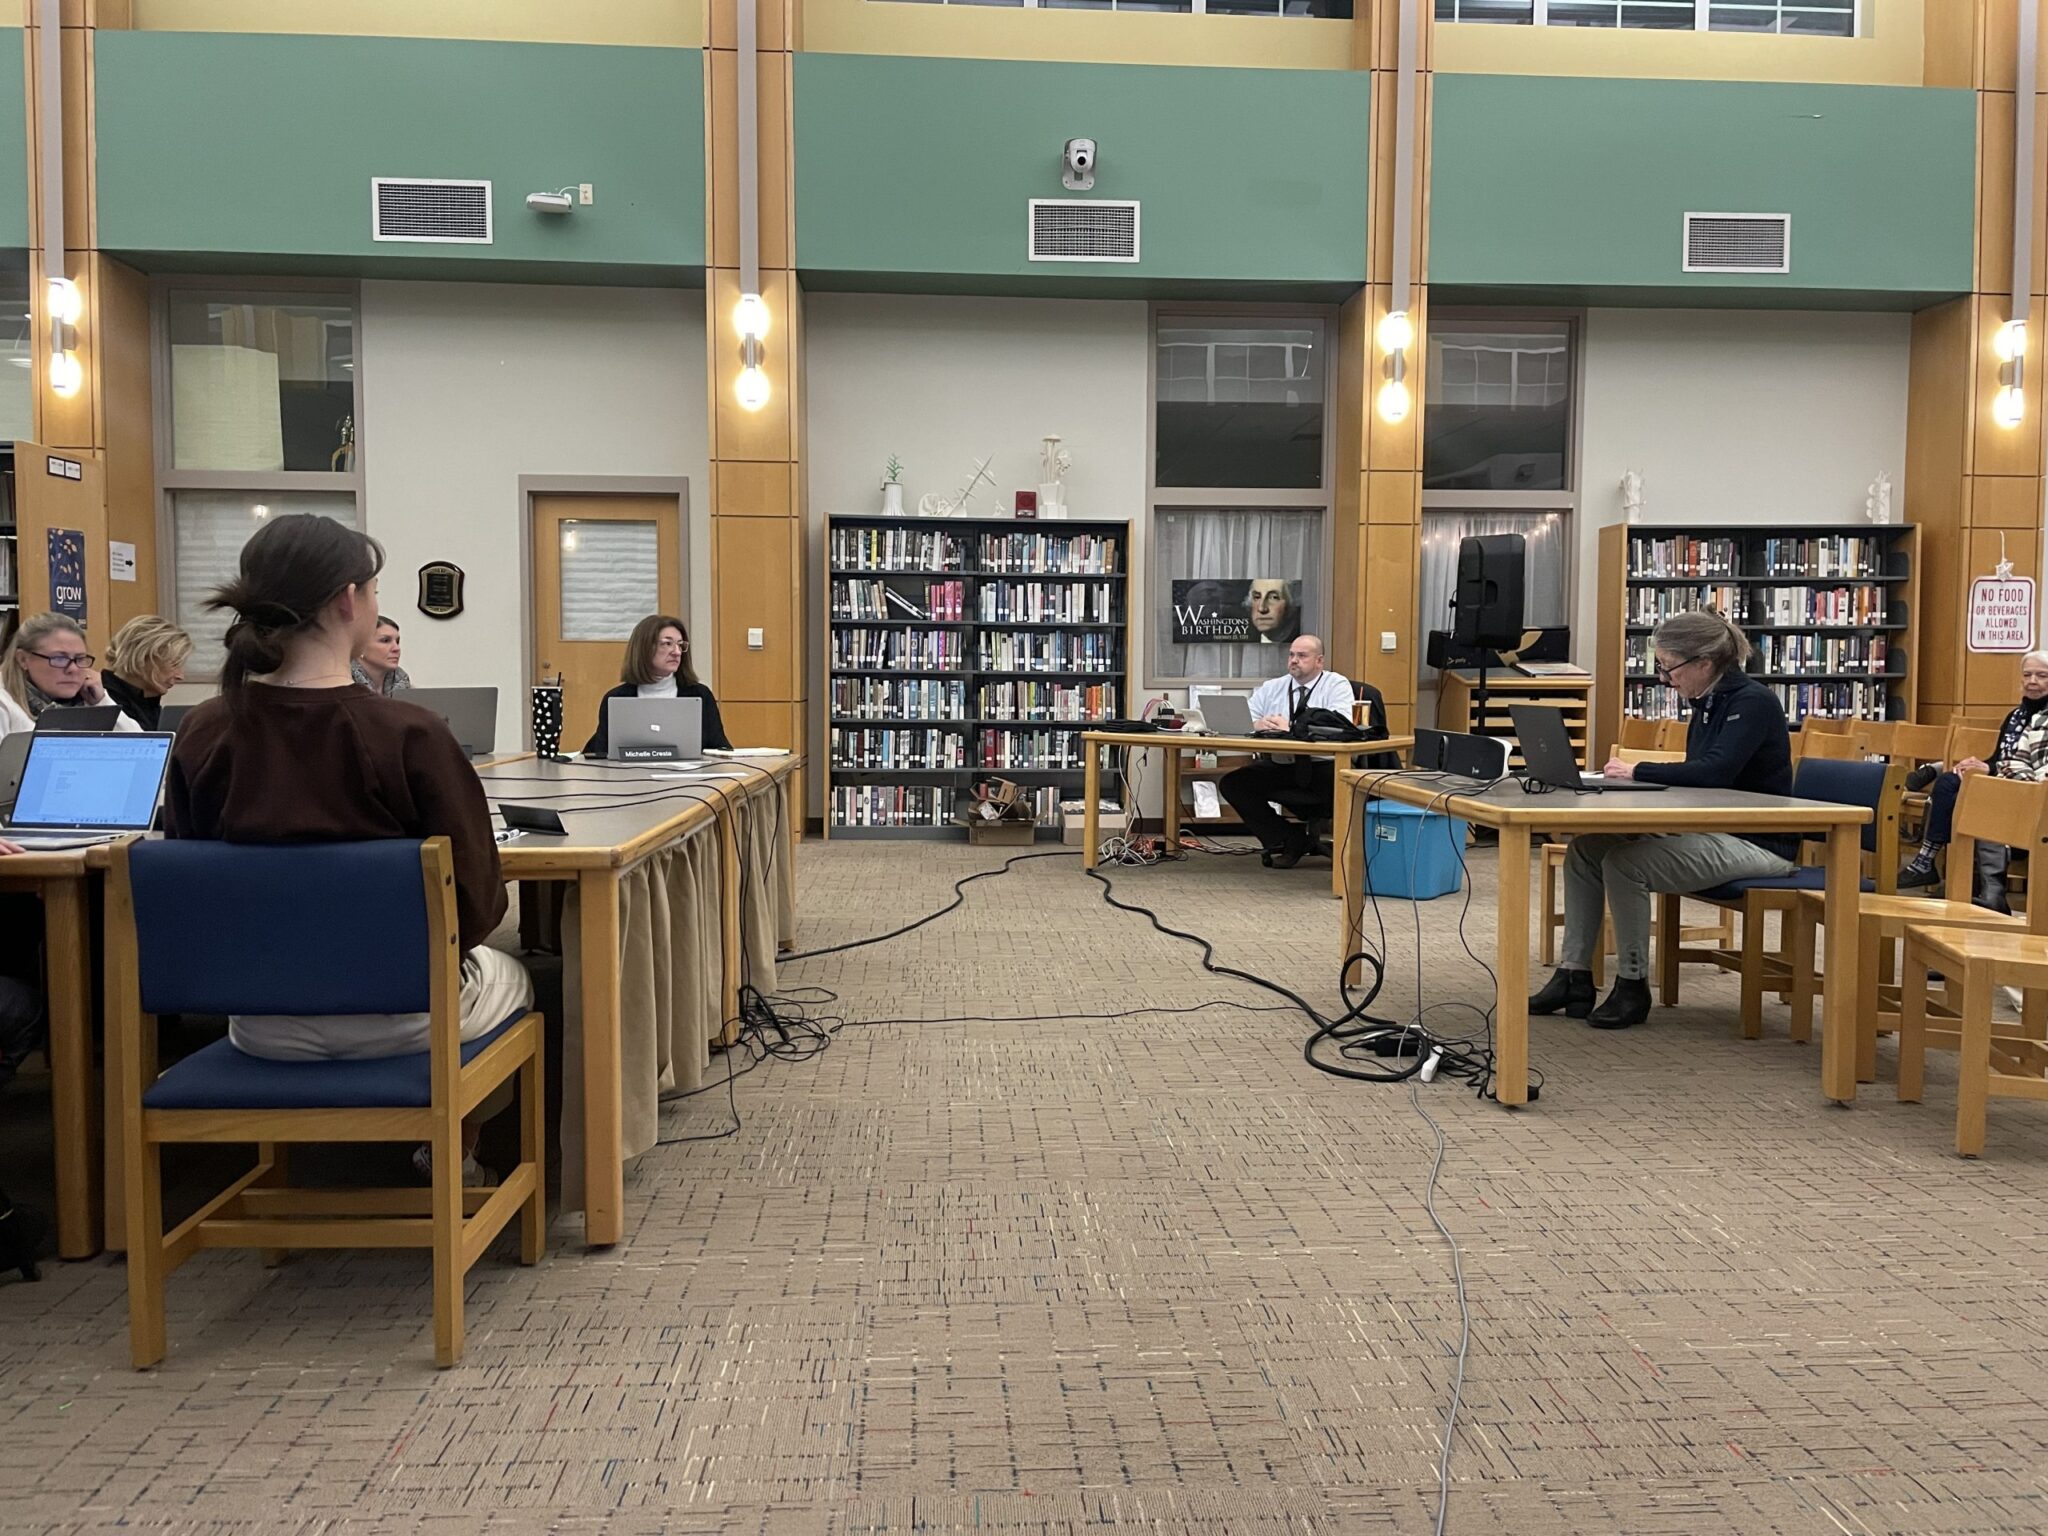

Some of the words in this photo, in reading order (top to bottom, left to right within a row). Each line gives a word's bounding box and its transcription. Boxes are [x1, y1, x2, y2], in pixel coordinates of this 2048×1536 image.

[56, 586, 82, 605] grow
[1981, 588, 1995, 602] NO
[1998, 588, 2024, 602] FOOD
[1975, 606, 1986, 616] OR
[1988, 605, 2028, 616] BEVERAGES
[1985, 618, 2018, 628] ALLOWED
[1182, 625, 1249, 635] BIRTHDAY
[1977, 631, 1986, 641] IN
[1988, 631, 2004, 641] THIS
[2006, 631, 2024, 641] AREA
